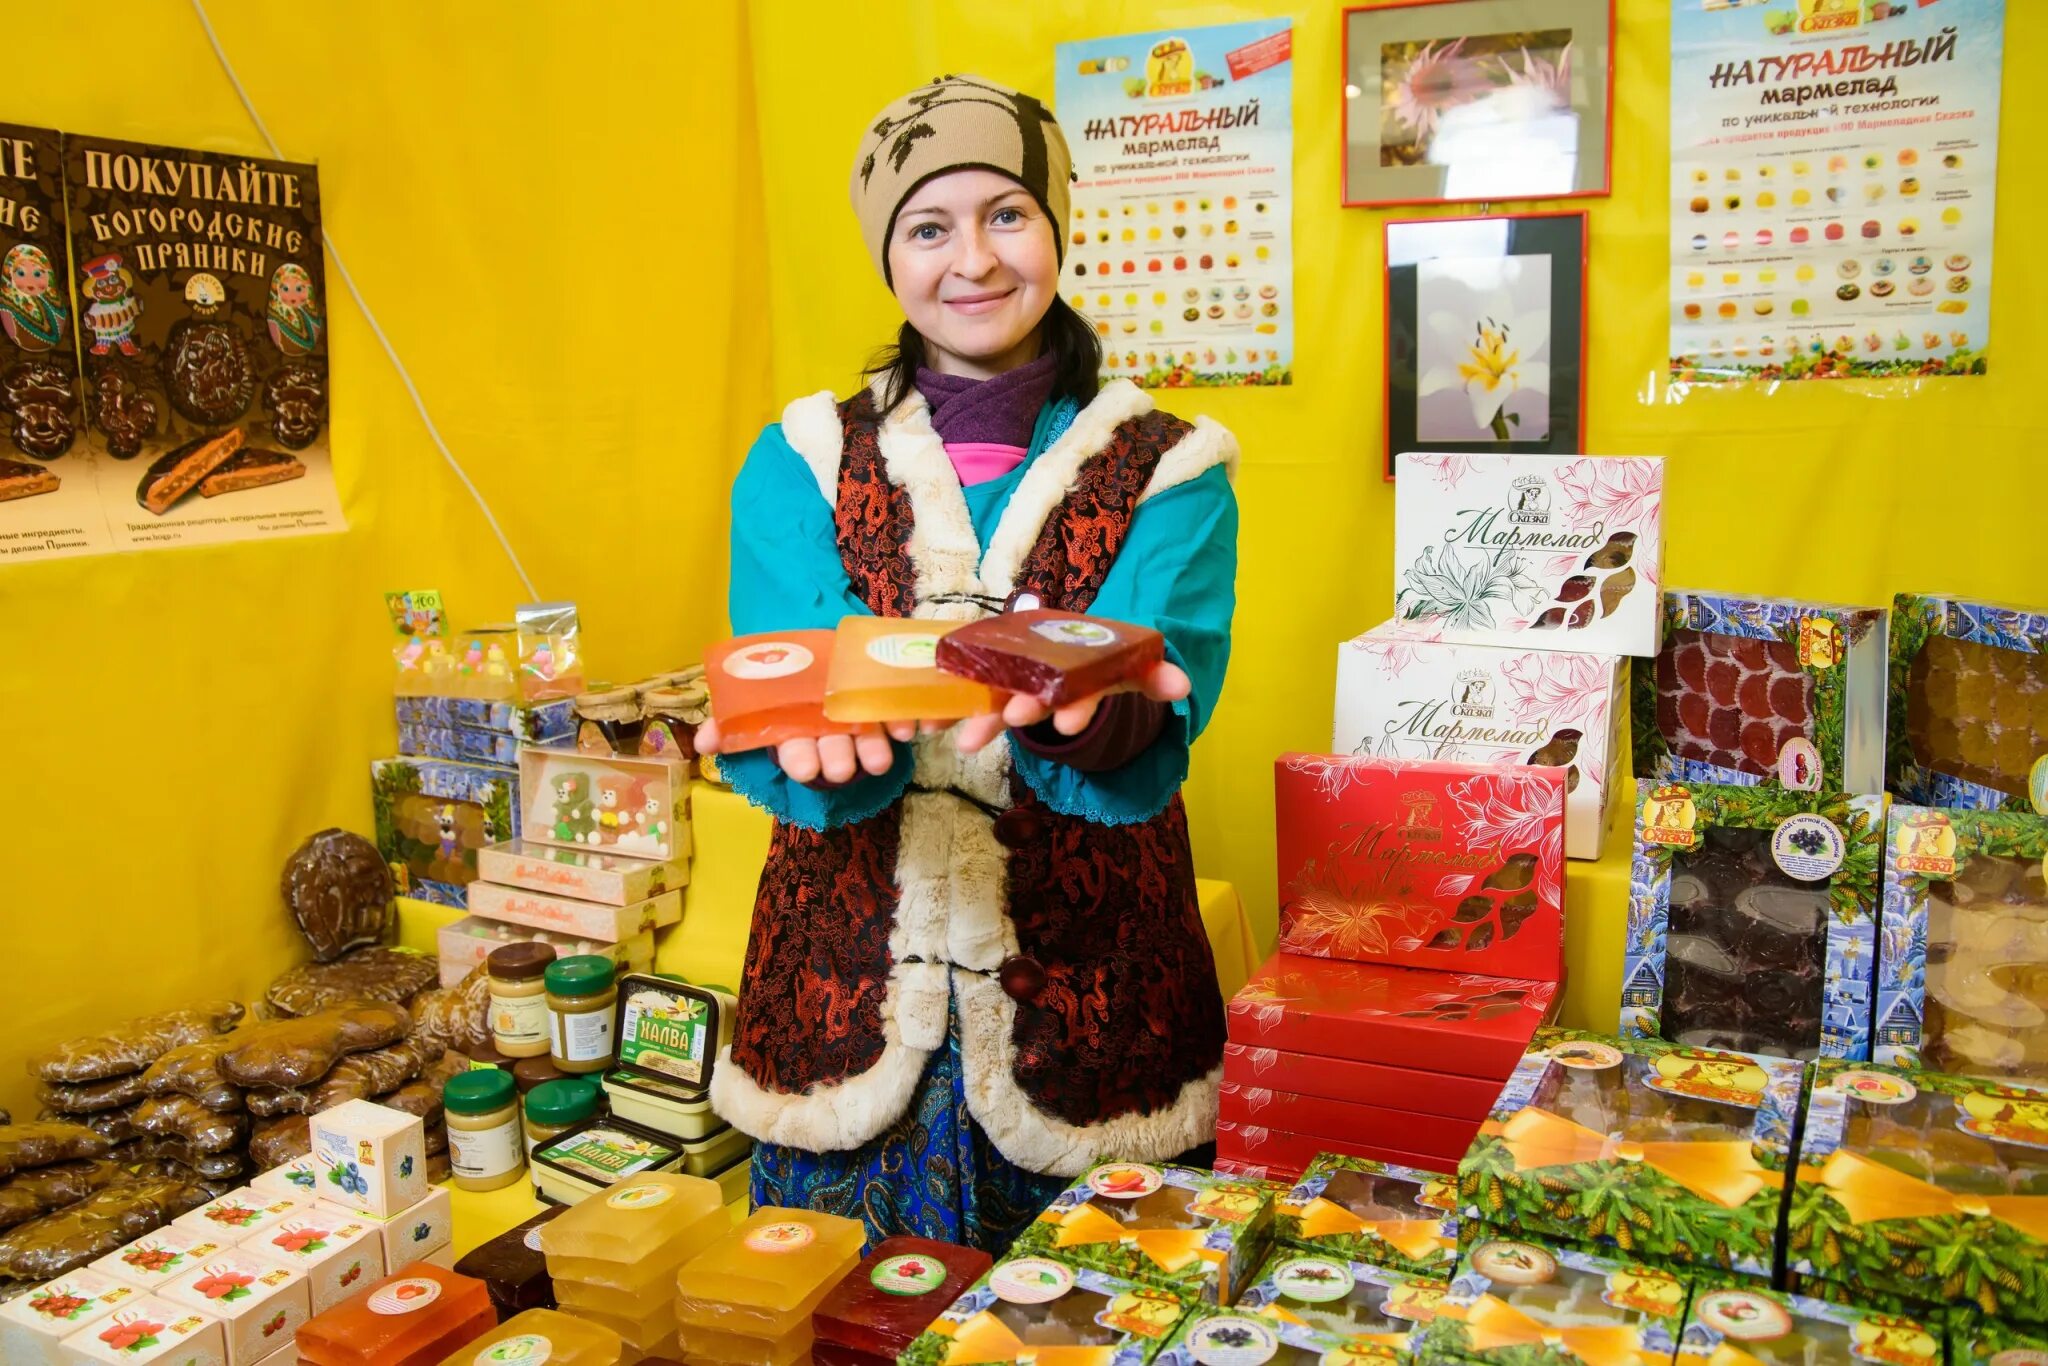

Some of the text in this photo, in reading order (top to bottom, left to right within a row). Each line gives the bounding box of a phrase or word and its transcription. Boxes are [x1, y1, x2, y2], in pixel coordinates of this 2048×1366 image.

[1710, 25, 1958, 88] НАТУРАЛЬНЫЙ
[1761, 76, 1897, 105] мармелад
[1084, 99, 1260, 141] НАТУРАЛЬНЫЙ
[1722, 115, 1740, 127] по
[1844, 95, 1940, 115] технологии
[1122, 135, 1221, 157] мармелад
[85, 150, 301, 208] ПОКУПАЙТЕ
[90, 207, 302, 254] БОГОРОДСКИЕ
[136, 242, 266, 278] ПРЯНИКИ
[1509, 513, 1549, 524] Сказка
[11, 545, 45, 554] делаем
[1444, 507, 1603, 567] Мармелад
[1384, 699, 1548, 760] Мармелад
[1452, 705, 1493, 718] Сказка
[1328, 821, 1501, 884] Мармелад
[1775, 822, 1793, 850] МАРМЕЛАД
[1820, 822, 1840, 858] СМОРОДИНОЙ
[640, 1020, 689, 1051] ХАЛВА
[574, 1143, 629, 1169] ХАЛВА
